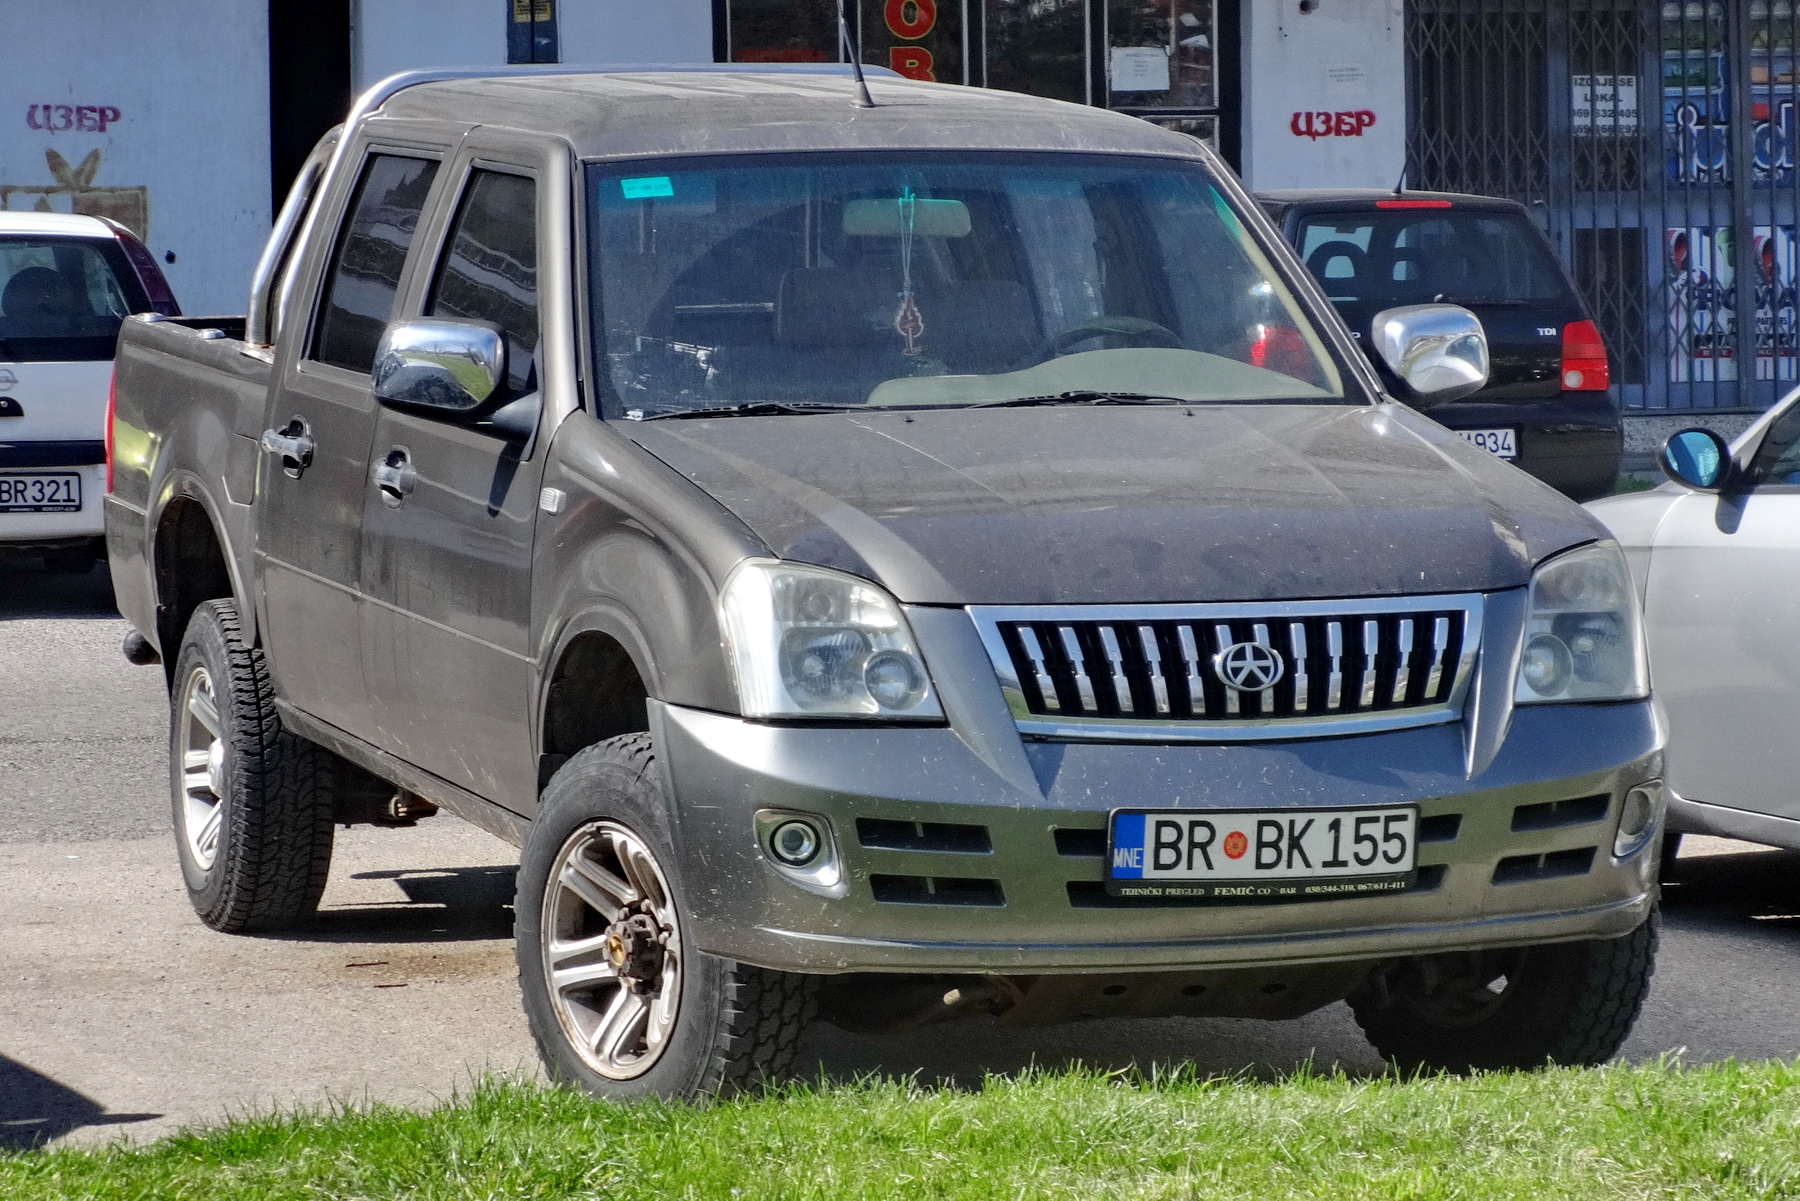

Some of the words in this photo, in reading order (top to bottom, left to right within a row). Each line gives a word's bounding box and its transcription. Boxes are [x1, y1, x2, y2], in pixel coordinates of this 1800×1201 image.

[27, 104, 121, 136] ЦЗБР
[1290, 109, 1376, 142] ЦЗБР
[1537, 328, 1557, 336] TDI
[1460, 431, 1512, 453] 934
[1153, 820, 1217, 870] BR
[1113, 847, 1143, 869] MNE
[1165, 888, 1205, 896] PREGLED
[1214, 885, 1255, 896] FEMIĆ
[1279, 887, 1297, 895] BAR
